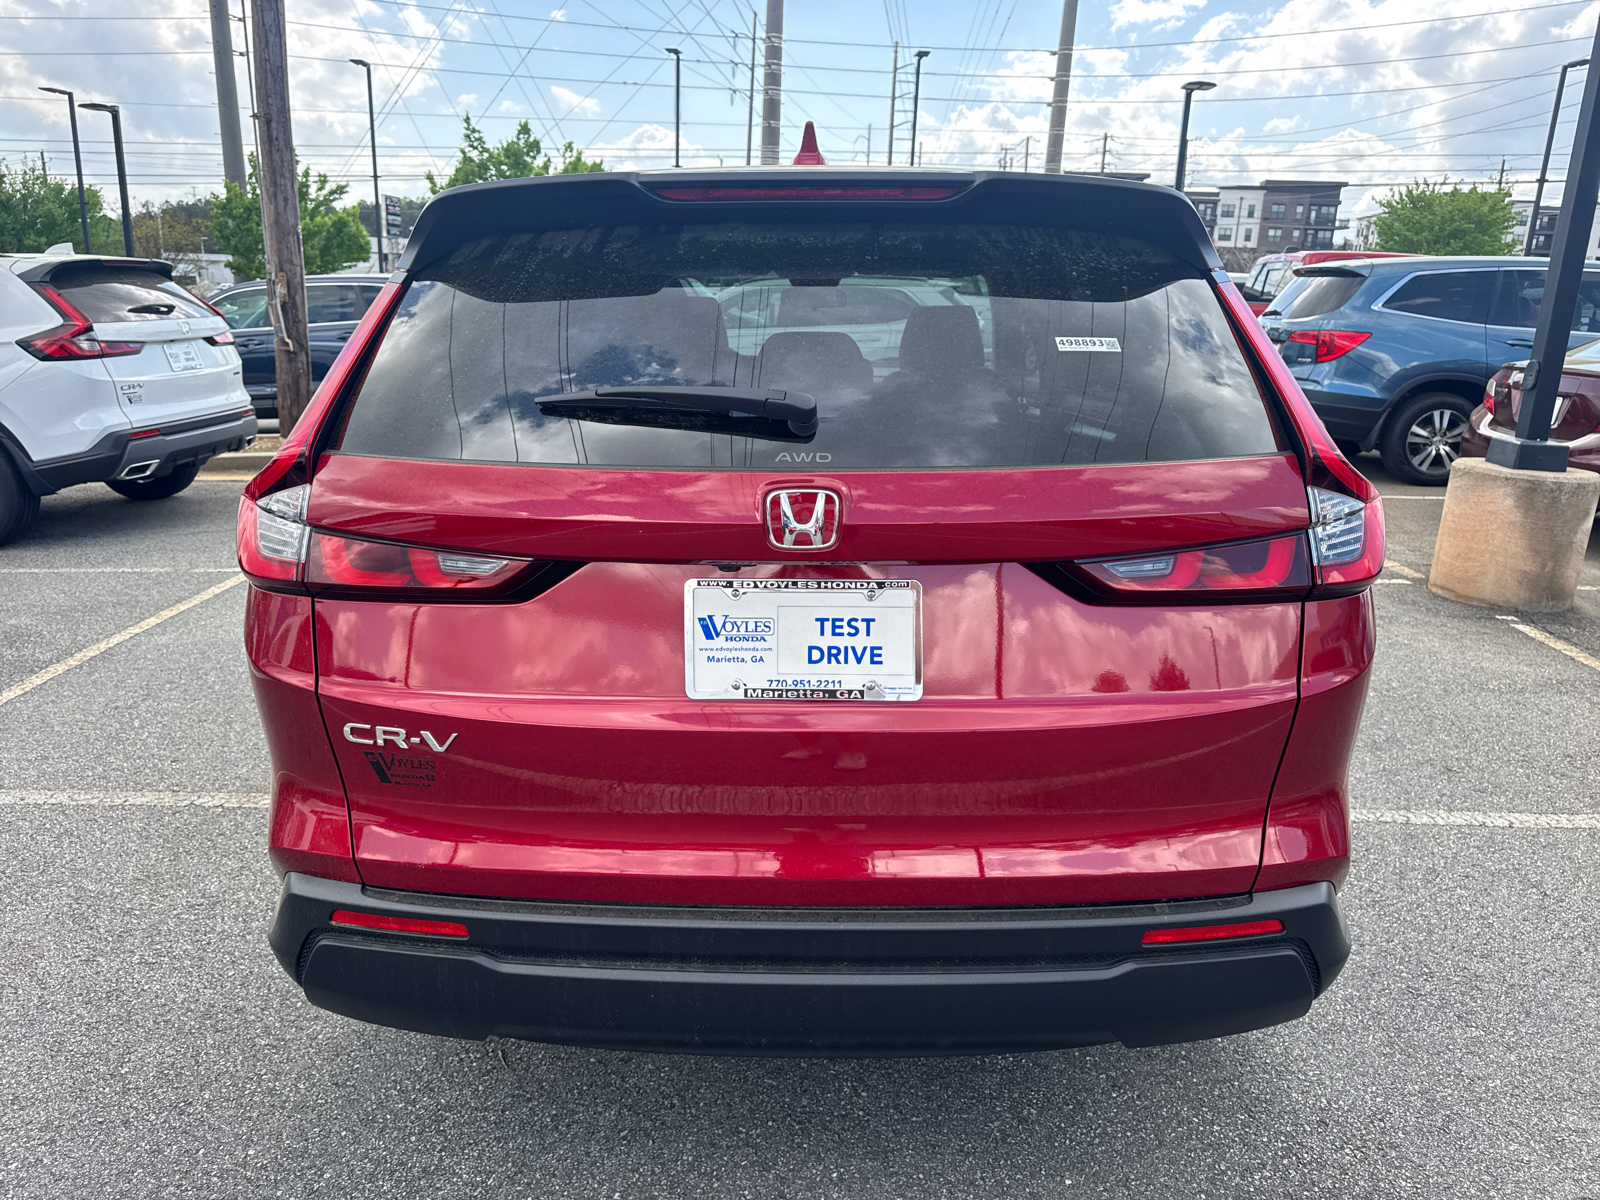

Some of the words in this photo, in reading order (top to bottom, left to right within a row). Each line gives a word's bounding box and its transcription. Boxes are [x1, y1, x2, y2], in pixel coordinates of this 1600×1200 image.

[1058, 339, 1104, 347] 498893
[775, 453, 832, 462] AWD
[815, 617, 876, 637] TEST
[706, 655, 748, 664] Marietta,
[807, 645, 883, 665] DRIVE
[766, 679, 842, 688] 770-951-2211
[746, 689, 829, 698] Marietta,
[836, 690, 862, 699] GA
[343, 722, 458, 752] CR-V
